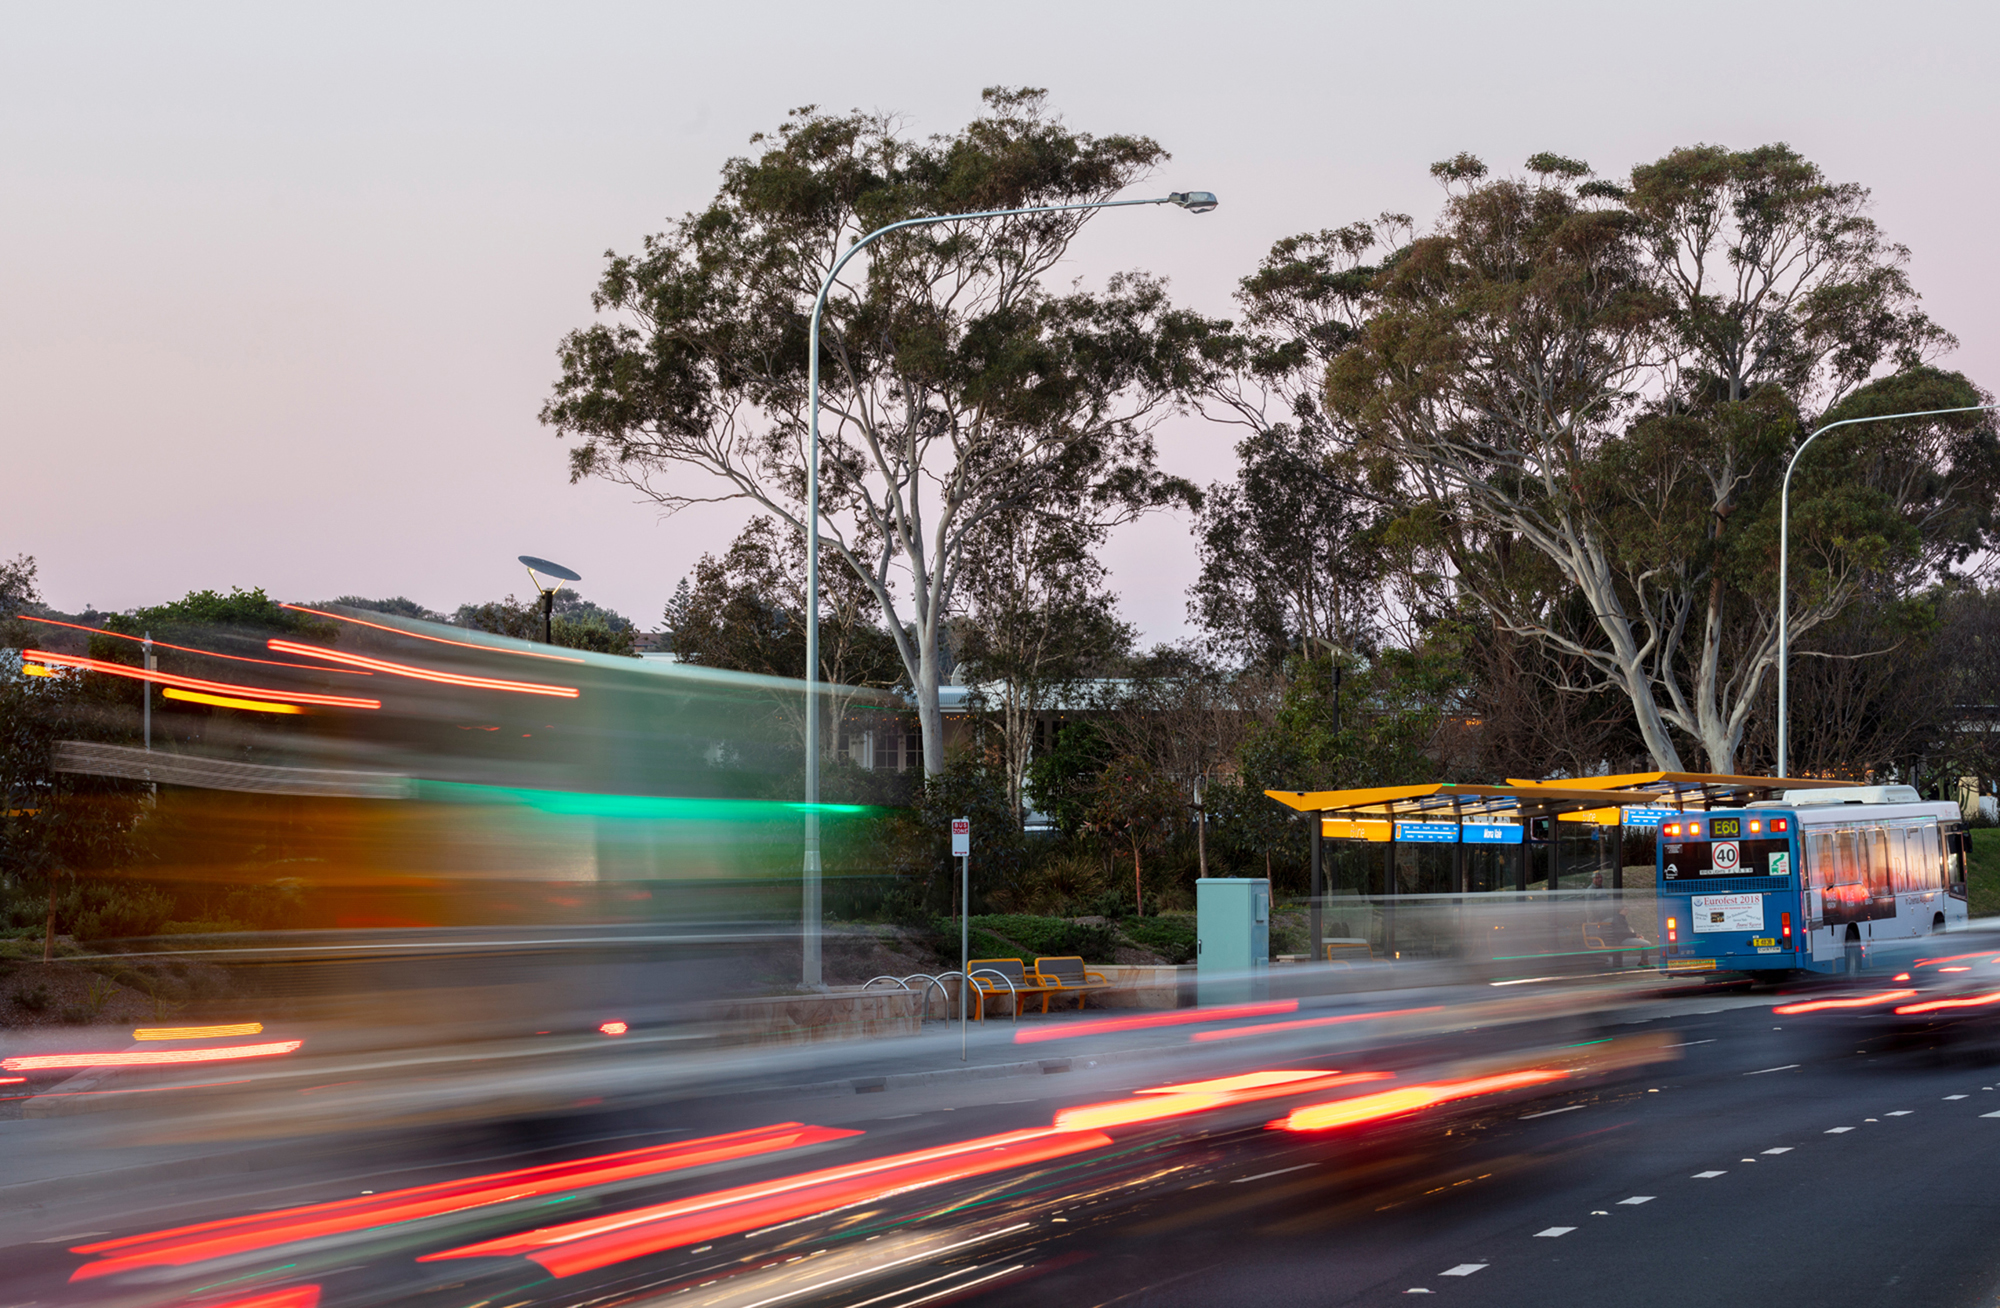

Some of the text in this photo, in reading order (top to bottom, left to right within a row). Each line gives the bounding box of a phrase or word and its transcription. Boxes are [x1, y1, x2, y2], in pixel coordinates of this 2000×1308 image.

[1714, 821, 1738, 834] E60
[1716, 849, 1736, 862] 40
[1704, 896, 1737, 905] Eurofest
[1740, 895, 1760, 904] 2018
